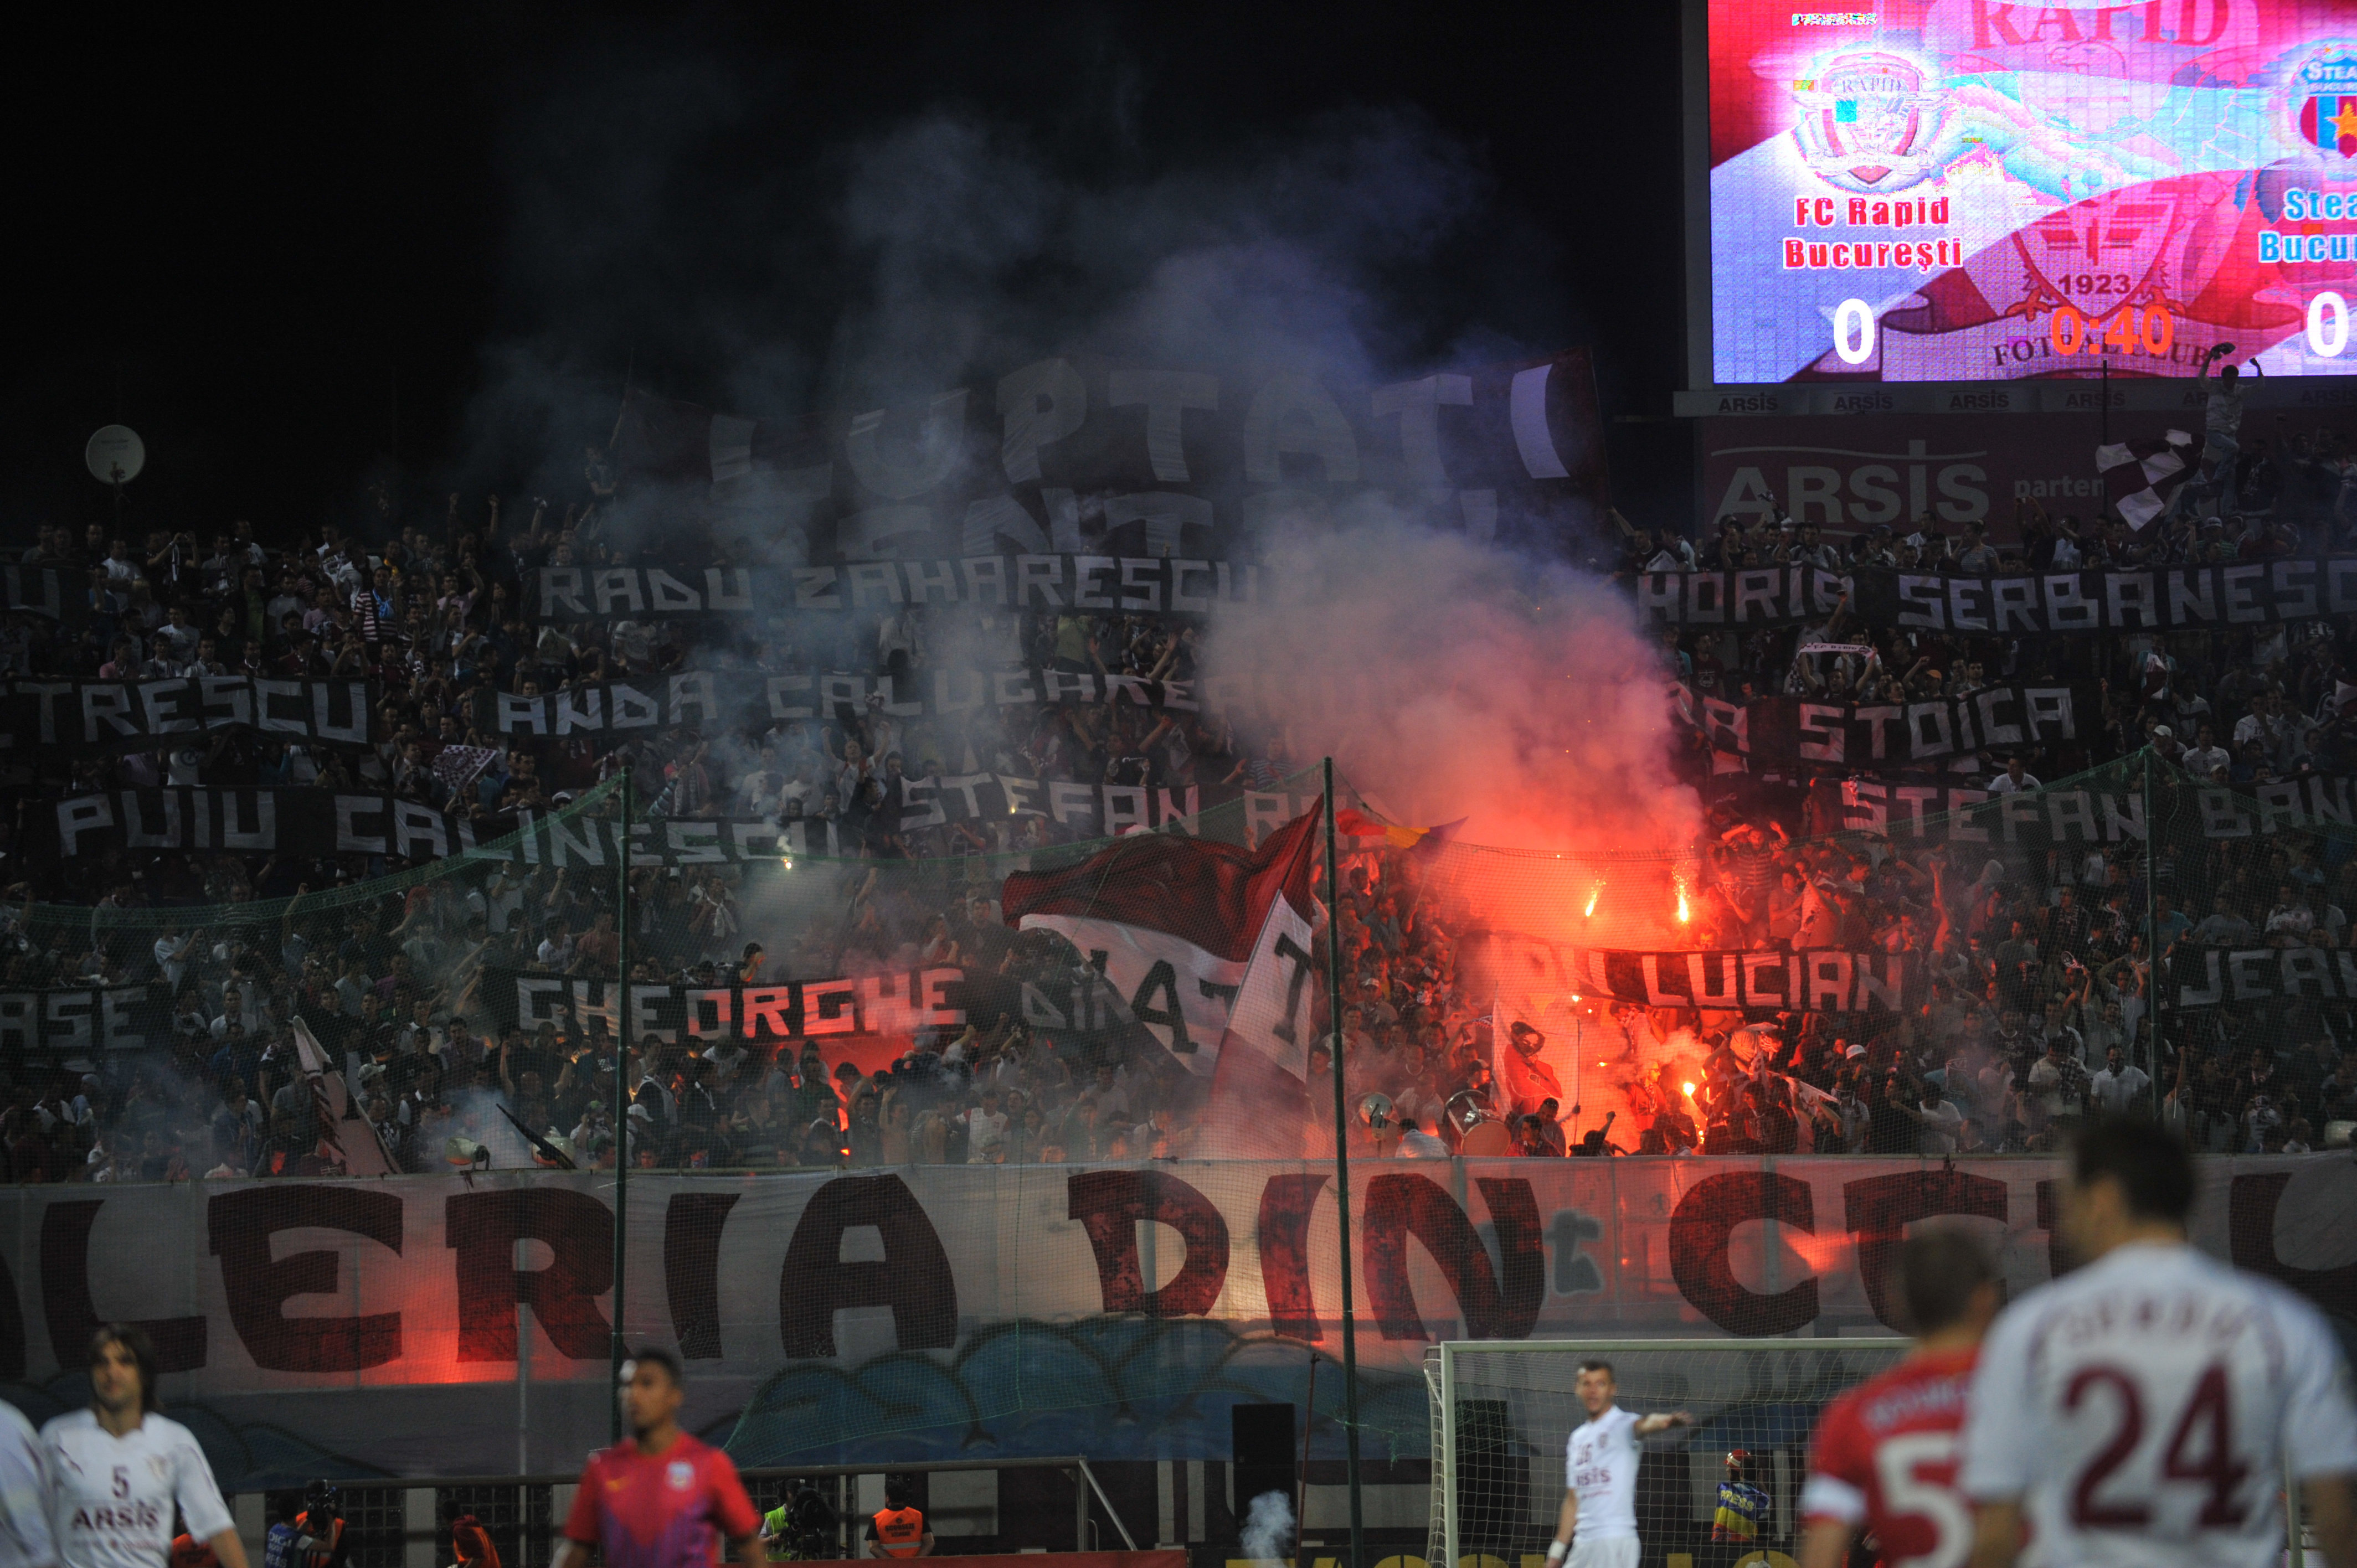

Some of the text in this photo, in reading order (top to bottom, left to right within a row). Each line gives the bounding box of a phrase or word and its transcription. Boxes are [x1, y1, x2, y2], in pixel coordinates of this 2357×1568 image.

[1795, 196, 1949, 228] FC Rapid
[2058, 274, 2132, 295] 1923
[1834, 298, 1875, 364] 0
[2051, 305, 2173, 355] 0:40
[2307, 291, 2349, 357] 0
[540, 567, 754, 616] RADU
[1637, 561, 1856, 624] HORIA
[497, 670, 718, 735] ANDA
[1799, 685, 2077, 763] STOICA
[57, 791, 840, 868] PUIU CALINESCU
[900, 772, 1199, 837] STEFAN
[1840, 780, 2146, 842] STEFAN
[517, 968, 966, 1044] GHEORGHE
[1641, 951, 1903, 1012] LUCIAN
[1068, 1169, 1545, 1341] DIN
[2061, 1360, 2250, 1529] 24
[112, 1465, 130, 1499] 5
[1720, 1489, 1755, 1512] PRESS
